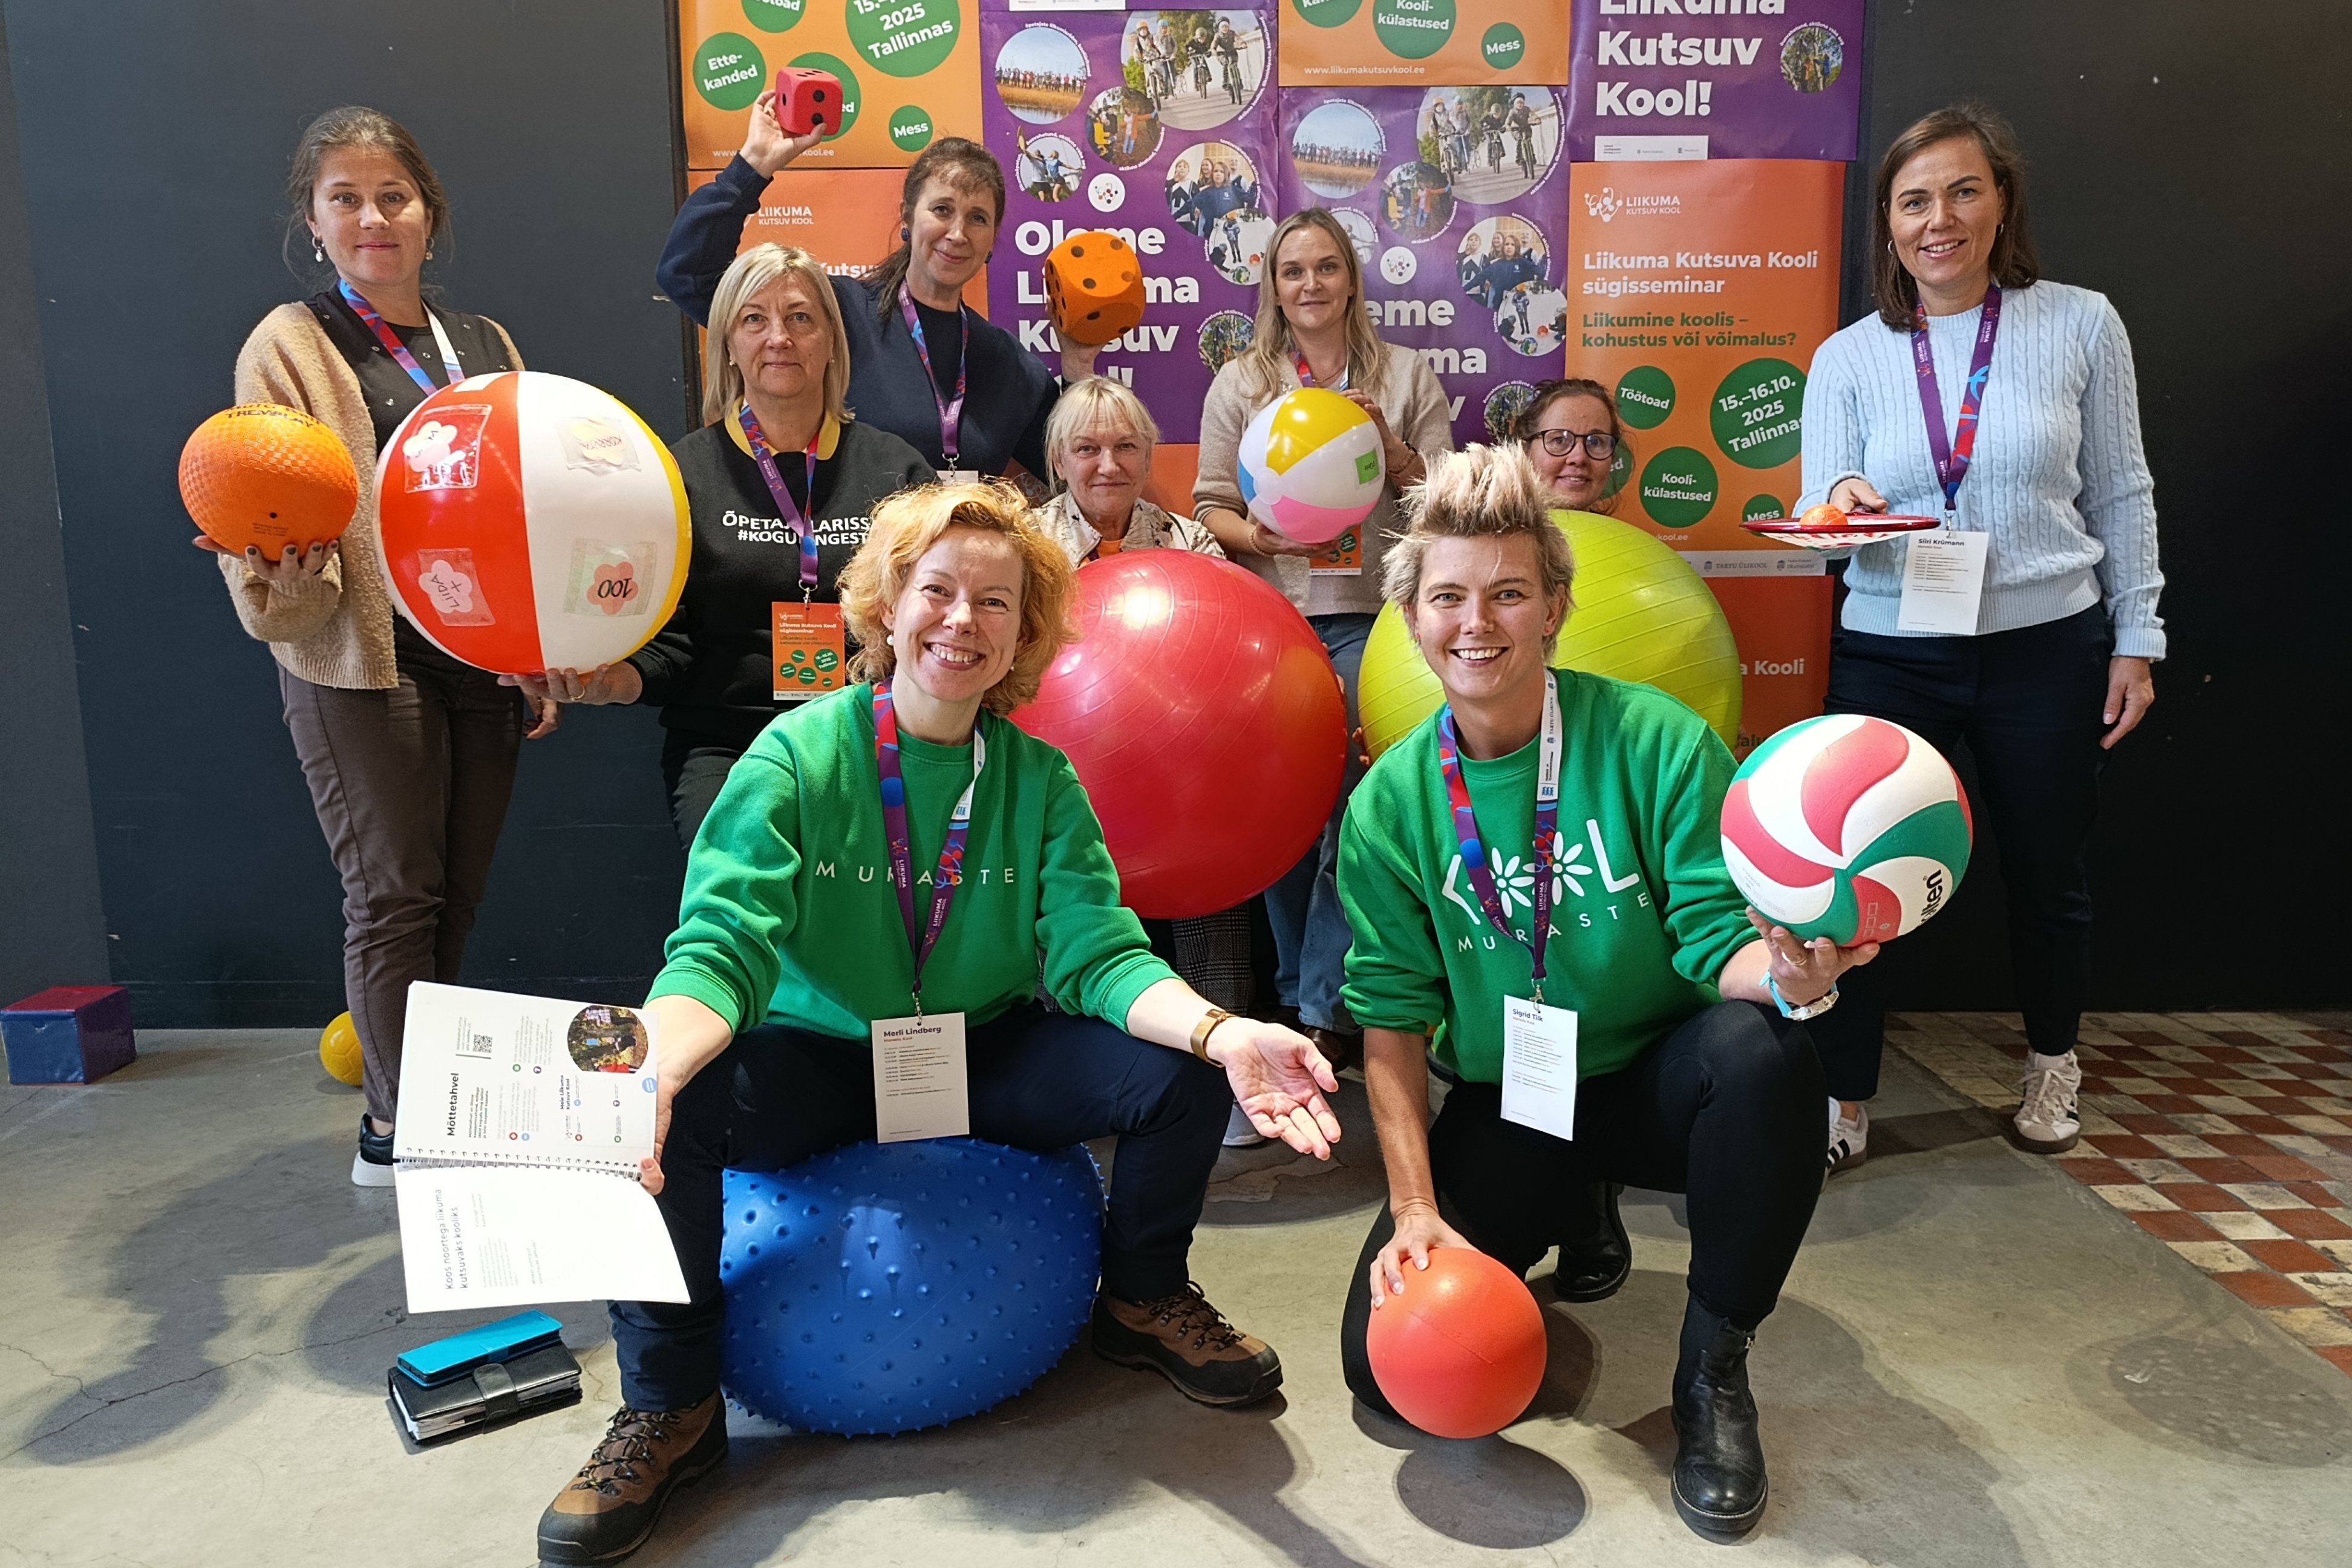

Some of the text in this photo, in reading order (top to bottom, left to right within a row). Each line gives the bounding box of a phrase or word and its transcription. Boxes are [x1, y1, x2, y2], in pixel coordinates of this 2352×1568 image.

[1396, 0, 1434, 11] Kooli-
[879, 2, 926, 31] 2025
[1377, 13, 1449, 30] külastused
[867, 20, 953, 59] Tallinnas
[1486, 39, 1520, 56] Mess
[1598, 31, 1763, 65] Kutsuv
[707, 53, 743, 71] Ette-
[1304, 65, 1425, 76] www.liikumakutsuvkool.ee
[704, 64, 759, 91] kanded
[1596, 80, 1712, 116] Kool!
[893, 121, 929, 139] Mess
[1626, 195, 1680, 206] LIIKUMA
[758, 206, 812, 217] LIIKUMA
[1014, 220, 1166, 255] Olme
[1584, 250, 1818, 269] Liikuma Kutsuva Kooli
[1583, 276, 1725, 298] sügisseminar
[1364, 299, 1455, 326] eme
[1582, 313, 1675, 328] Liikumine
[1680, 312, 1734, 327] koolis
[1582, 332, 1797, 347] kohustus või võimalus?
[1619, 387, 1671, 410] Töötoad
[1742, 400, 1785, 426] 2025
[1662, 473, 1697, 485] Kooli-
[1644, 486, 1712, 502] külastused
[722, 510, 870, 532] ÕPETAJ LARISS
[1747, 509, 1780, 522] Mess
[737, 529, 868, 546] #KOGUNGEST
[598, 577, 632, 599] 100
[1754, 658, 1805, 675] Kooli
[815, 860, 1014, 886] MURATE
[933, 898, 943, 926] LIIKUMA
[1458, 893, 1650, 953] MURASTE
[1512, 1008, 1544, 1022] Sigrid Tilk
[884, 1026, 942, 1037] Merli Lindberg
[447, 1073, 460, 1137] Mõttetahvel
[434, 1189, 454, 1290] Koos noortega liikuma
[450, 1206, 469, 1289] kutsuvaks kooliks
